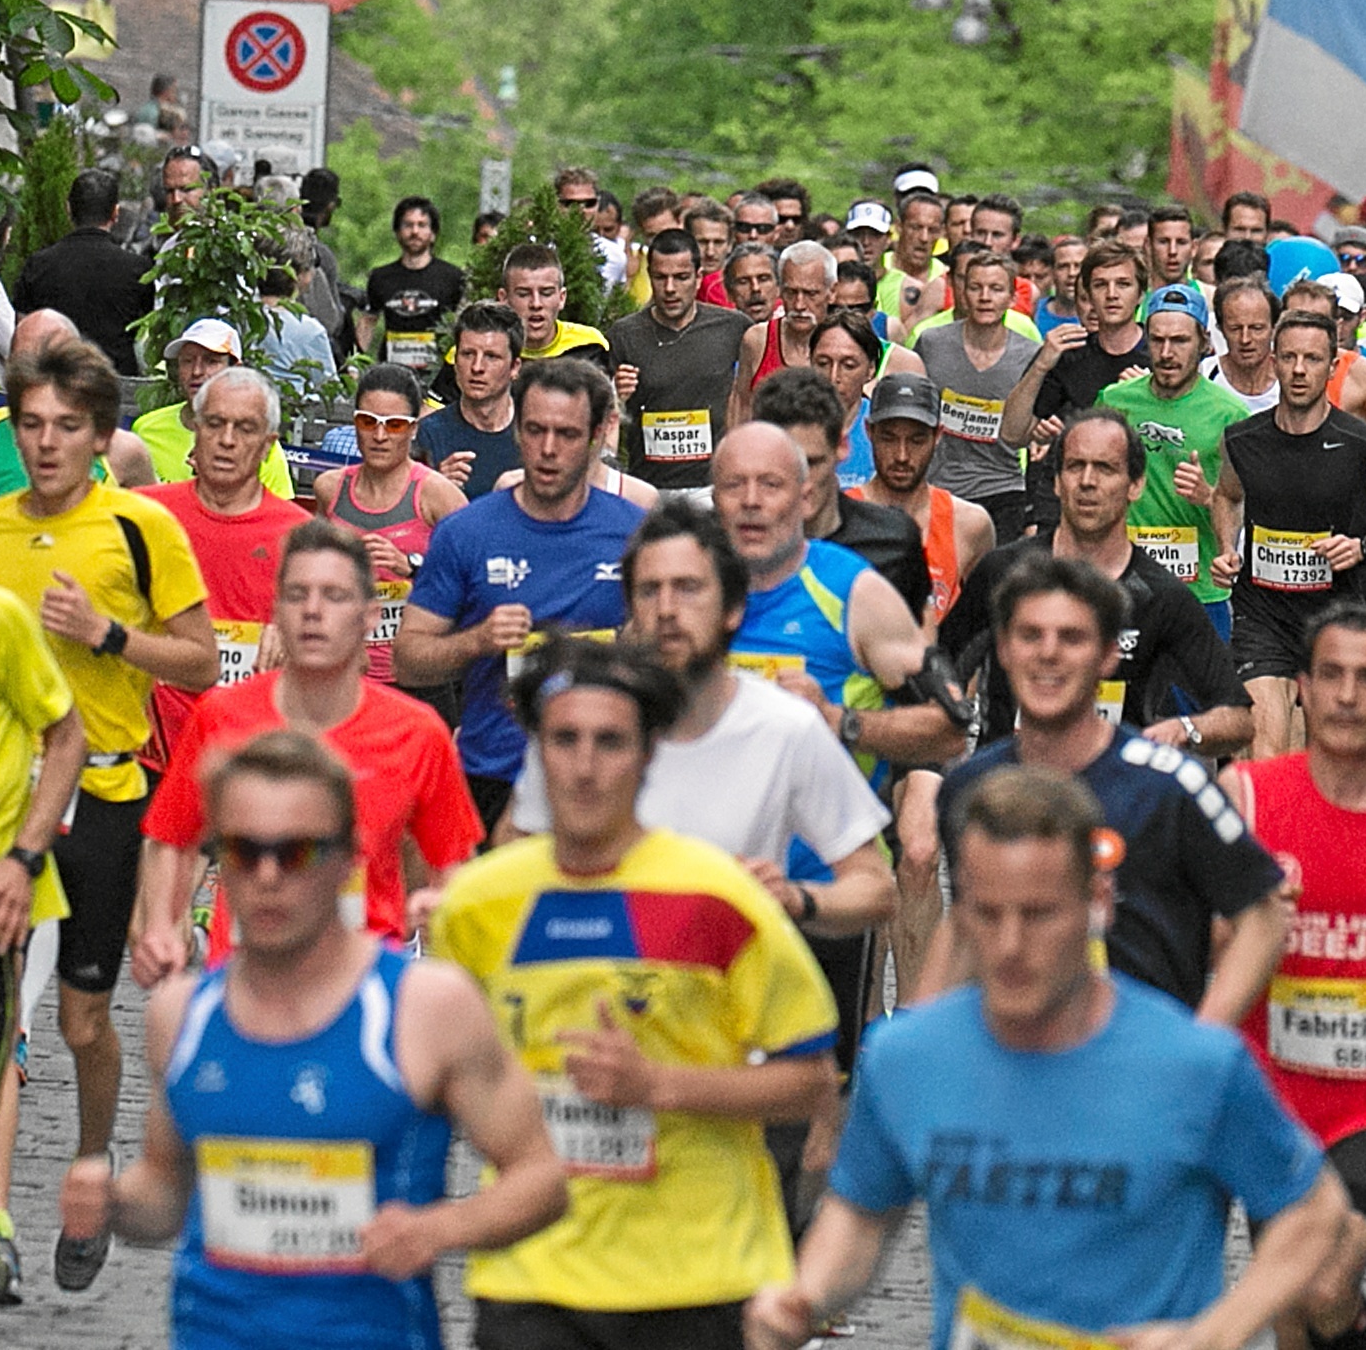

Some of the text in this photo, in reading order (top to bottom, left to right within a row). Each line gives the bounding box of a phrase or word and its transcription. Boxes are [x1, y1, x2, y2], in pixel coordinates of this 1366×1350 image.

[942, 403, 999, 426] Benjamin
[653, 428, 700, 443] Kaspar
[671, 442, 707, 455] 16179
[1143, 545, 1180, 560] evin
[1257, 546, 1327, 566] Christian
[1283, 569, 1327, 582] 17392
